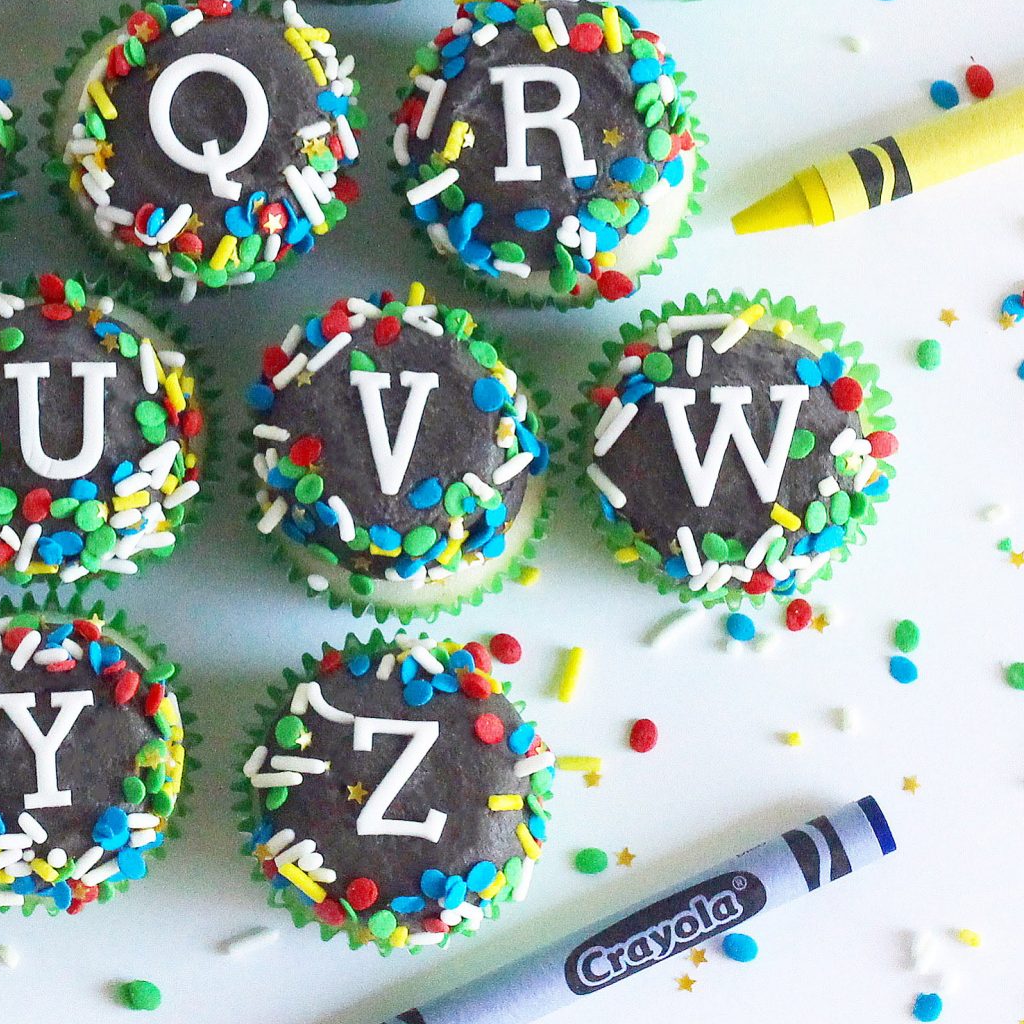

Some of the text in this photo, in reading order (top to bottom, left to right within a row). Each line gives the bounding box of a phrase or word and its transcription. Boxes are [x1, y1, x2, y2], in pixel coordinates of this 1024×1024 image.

[149, 53, 268, 201] Q
[490, 64, 597, 181] R
[4, 362, 116, 480] U
[350, 371, 439, 495] V
[655, 384, 809, 507] W
[353, 716, 447, 843] Z
[577, 890, 743, 986] Crayola
